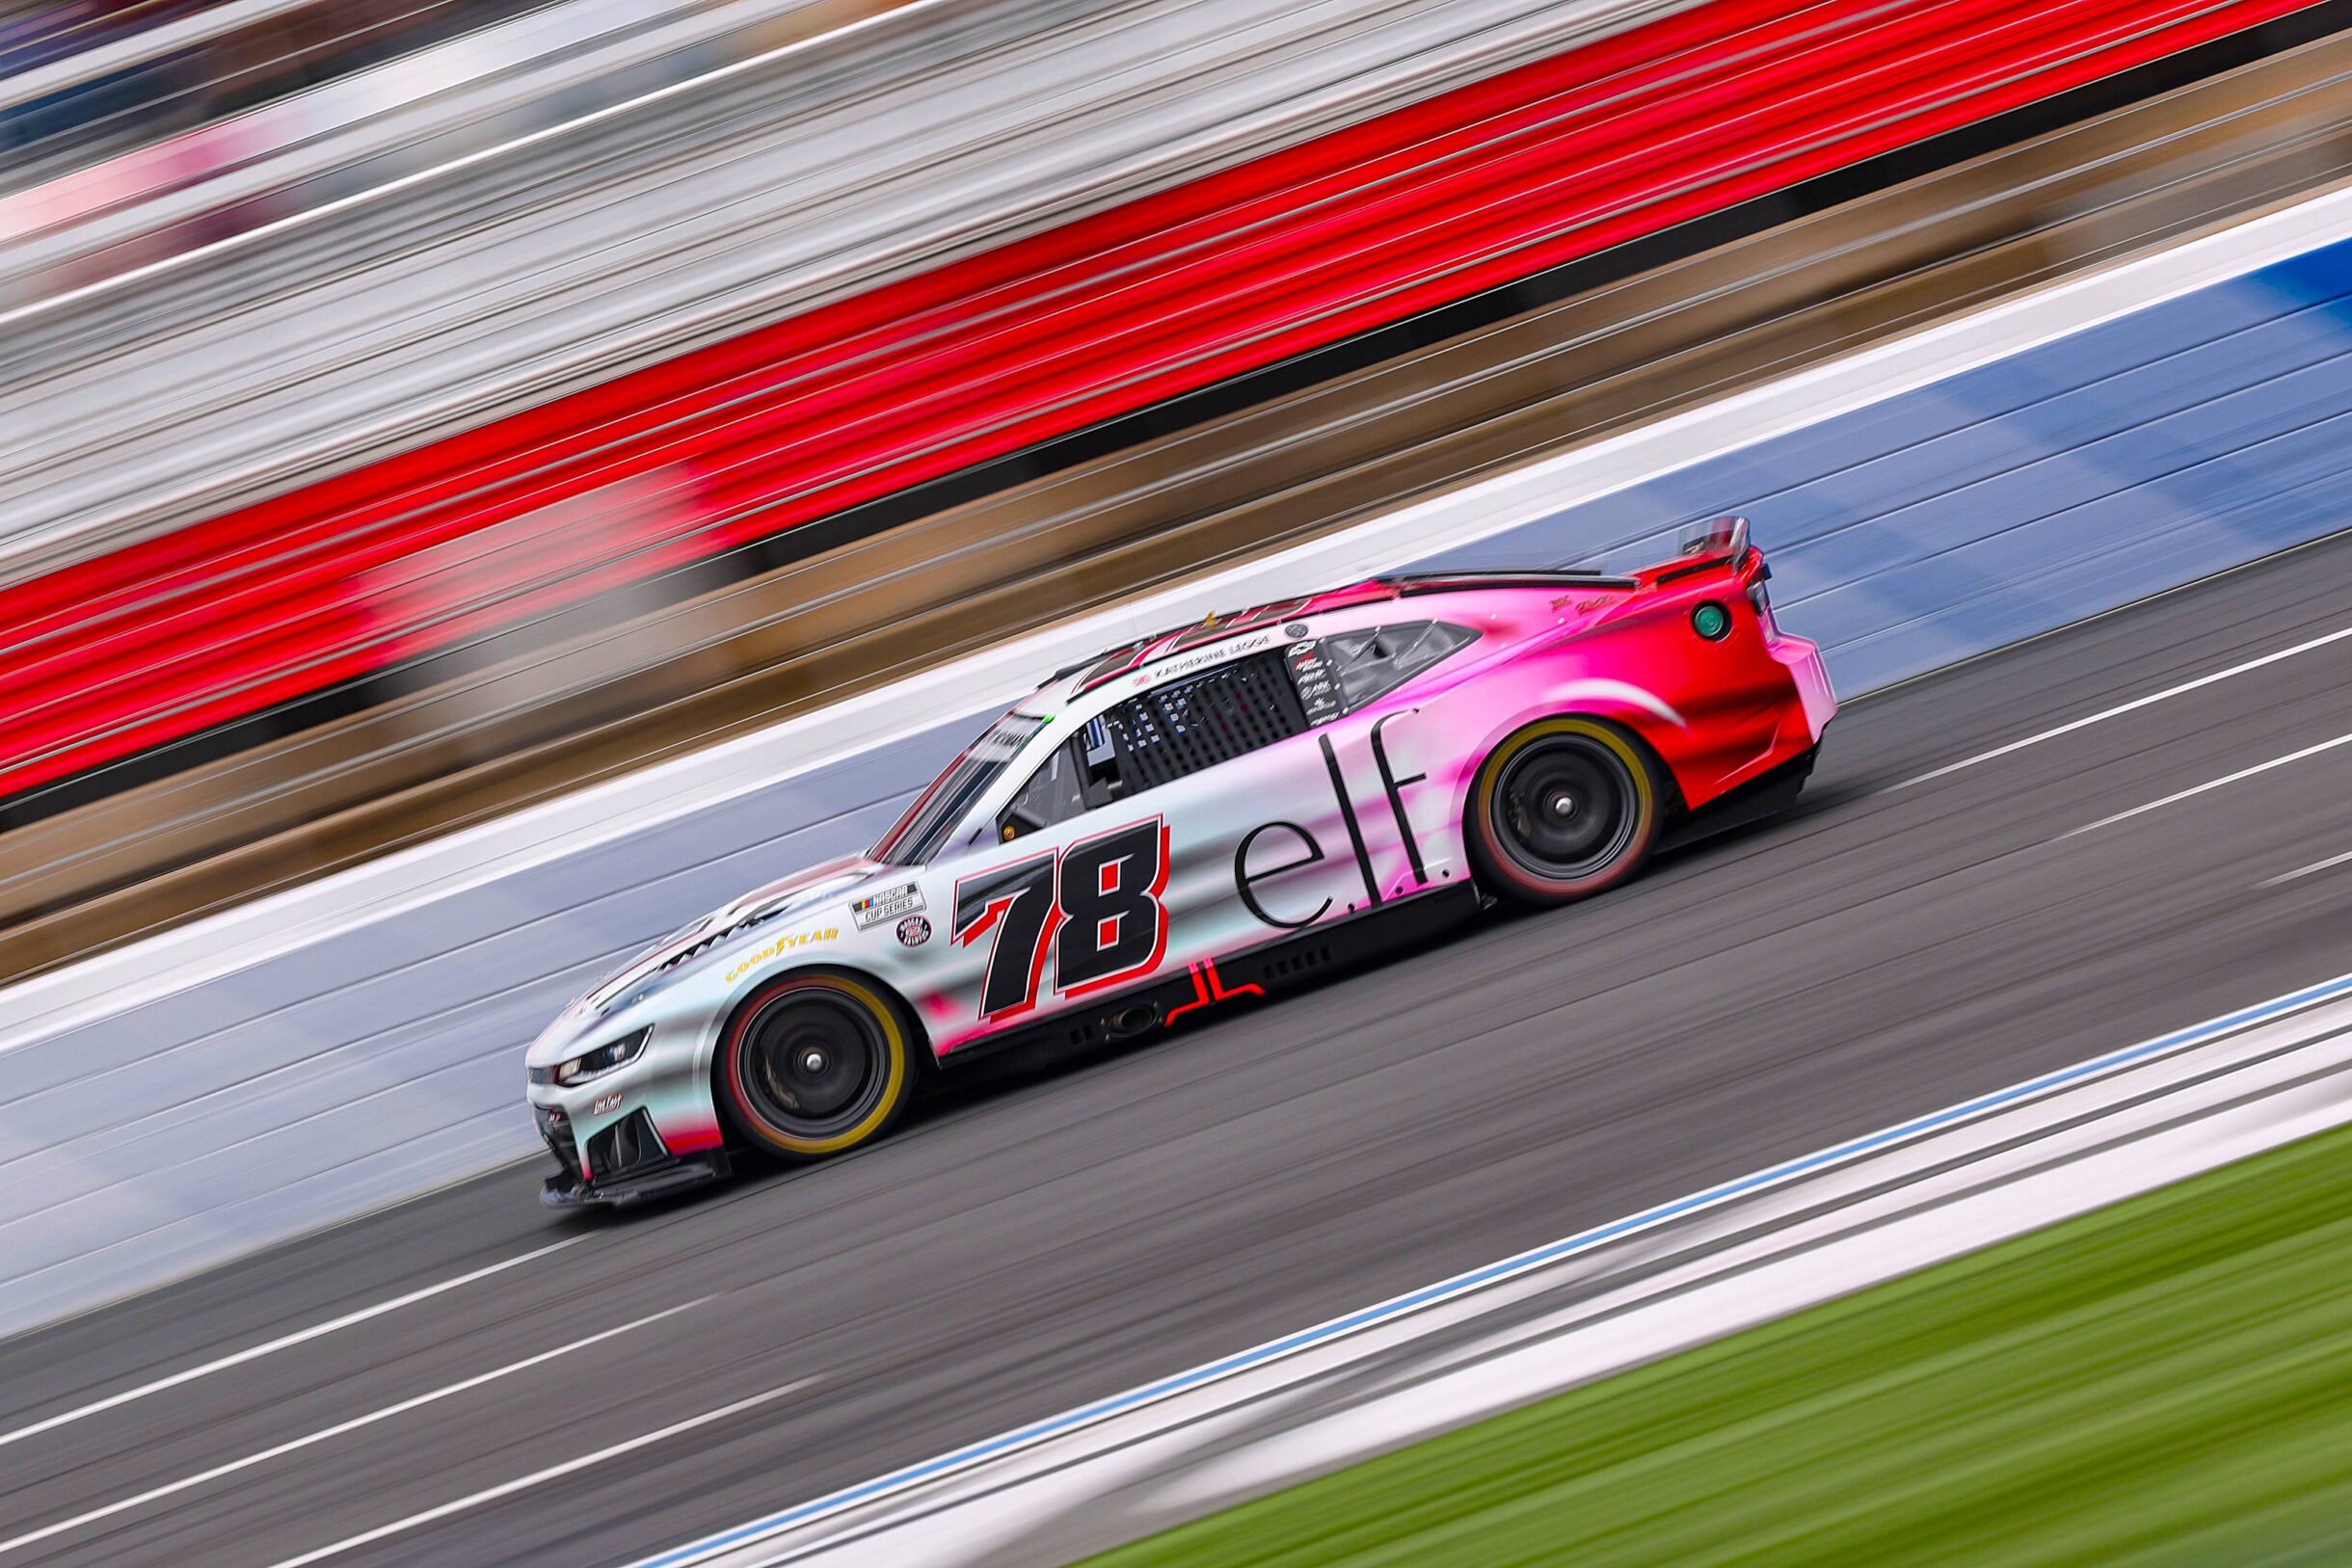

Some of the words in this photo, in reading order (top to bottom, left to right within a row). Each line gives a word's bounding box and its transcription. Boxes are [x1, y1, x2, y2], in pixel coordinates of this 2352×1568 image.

[866, 907, 883, 923] CUP
[884, 897, 914, 917] SERIES
[873, 885, 908, 907] NASCAR
[950, 812, 1170, 1024] 78
[726, 927, 840, 982] GOODYEAR
